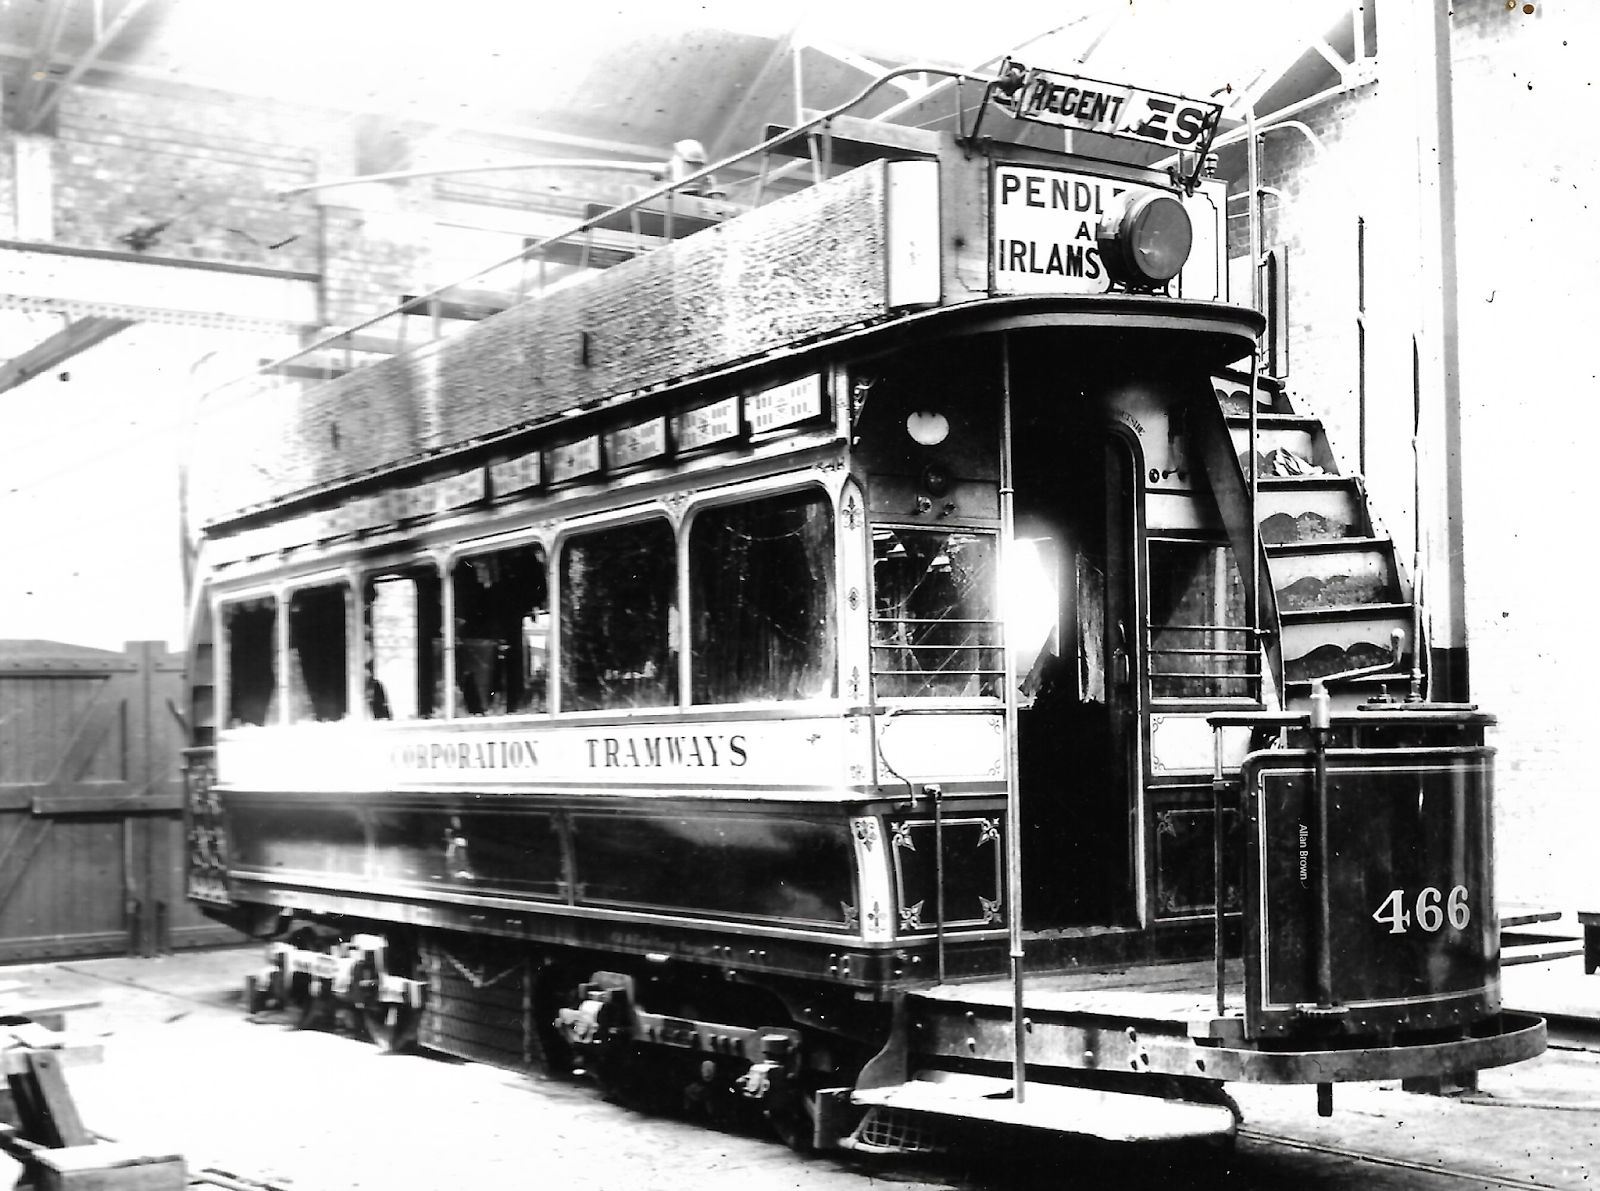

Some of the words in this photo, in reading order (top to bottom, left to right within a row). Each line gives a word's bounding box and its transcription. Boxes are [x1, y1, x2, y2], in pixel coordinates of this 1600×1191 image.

[1029, 78, 1124, 124] REGENT
[1001, 174, 1126, 215] PENDL
[390, 740, 540, 769] CORPORATION
[585, 735, 748, 768] TRAMWAYS
[1371, 884, 1471, 934] 466
